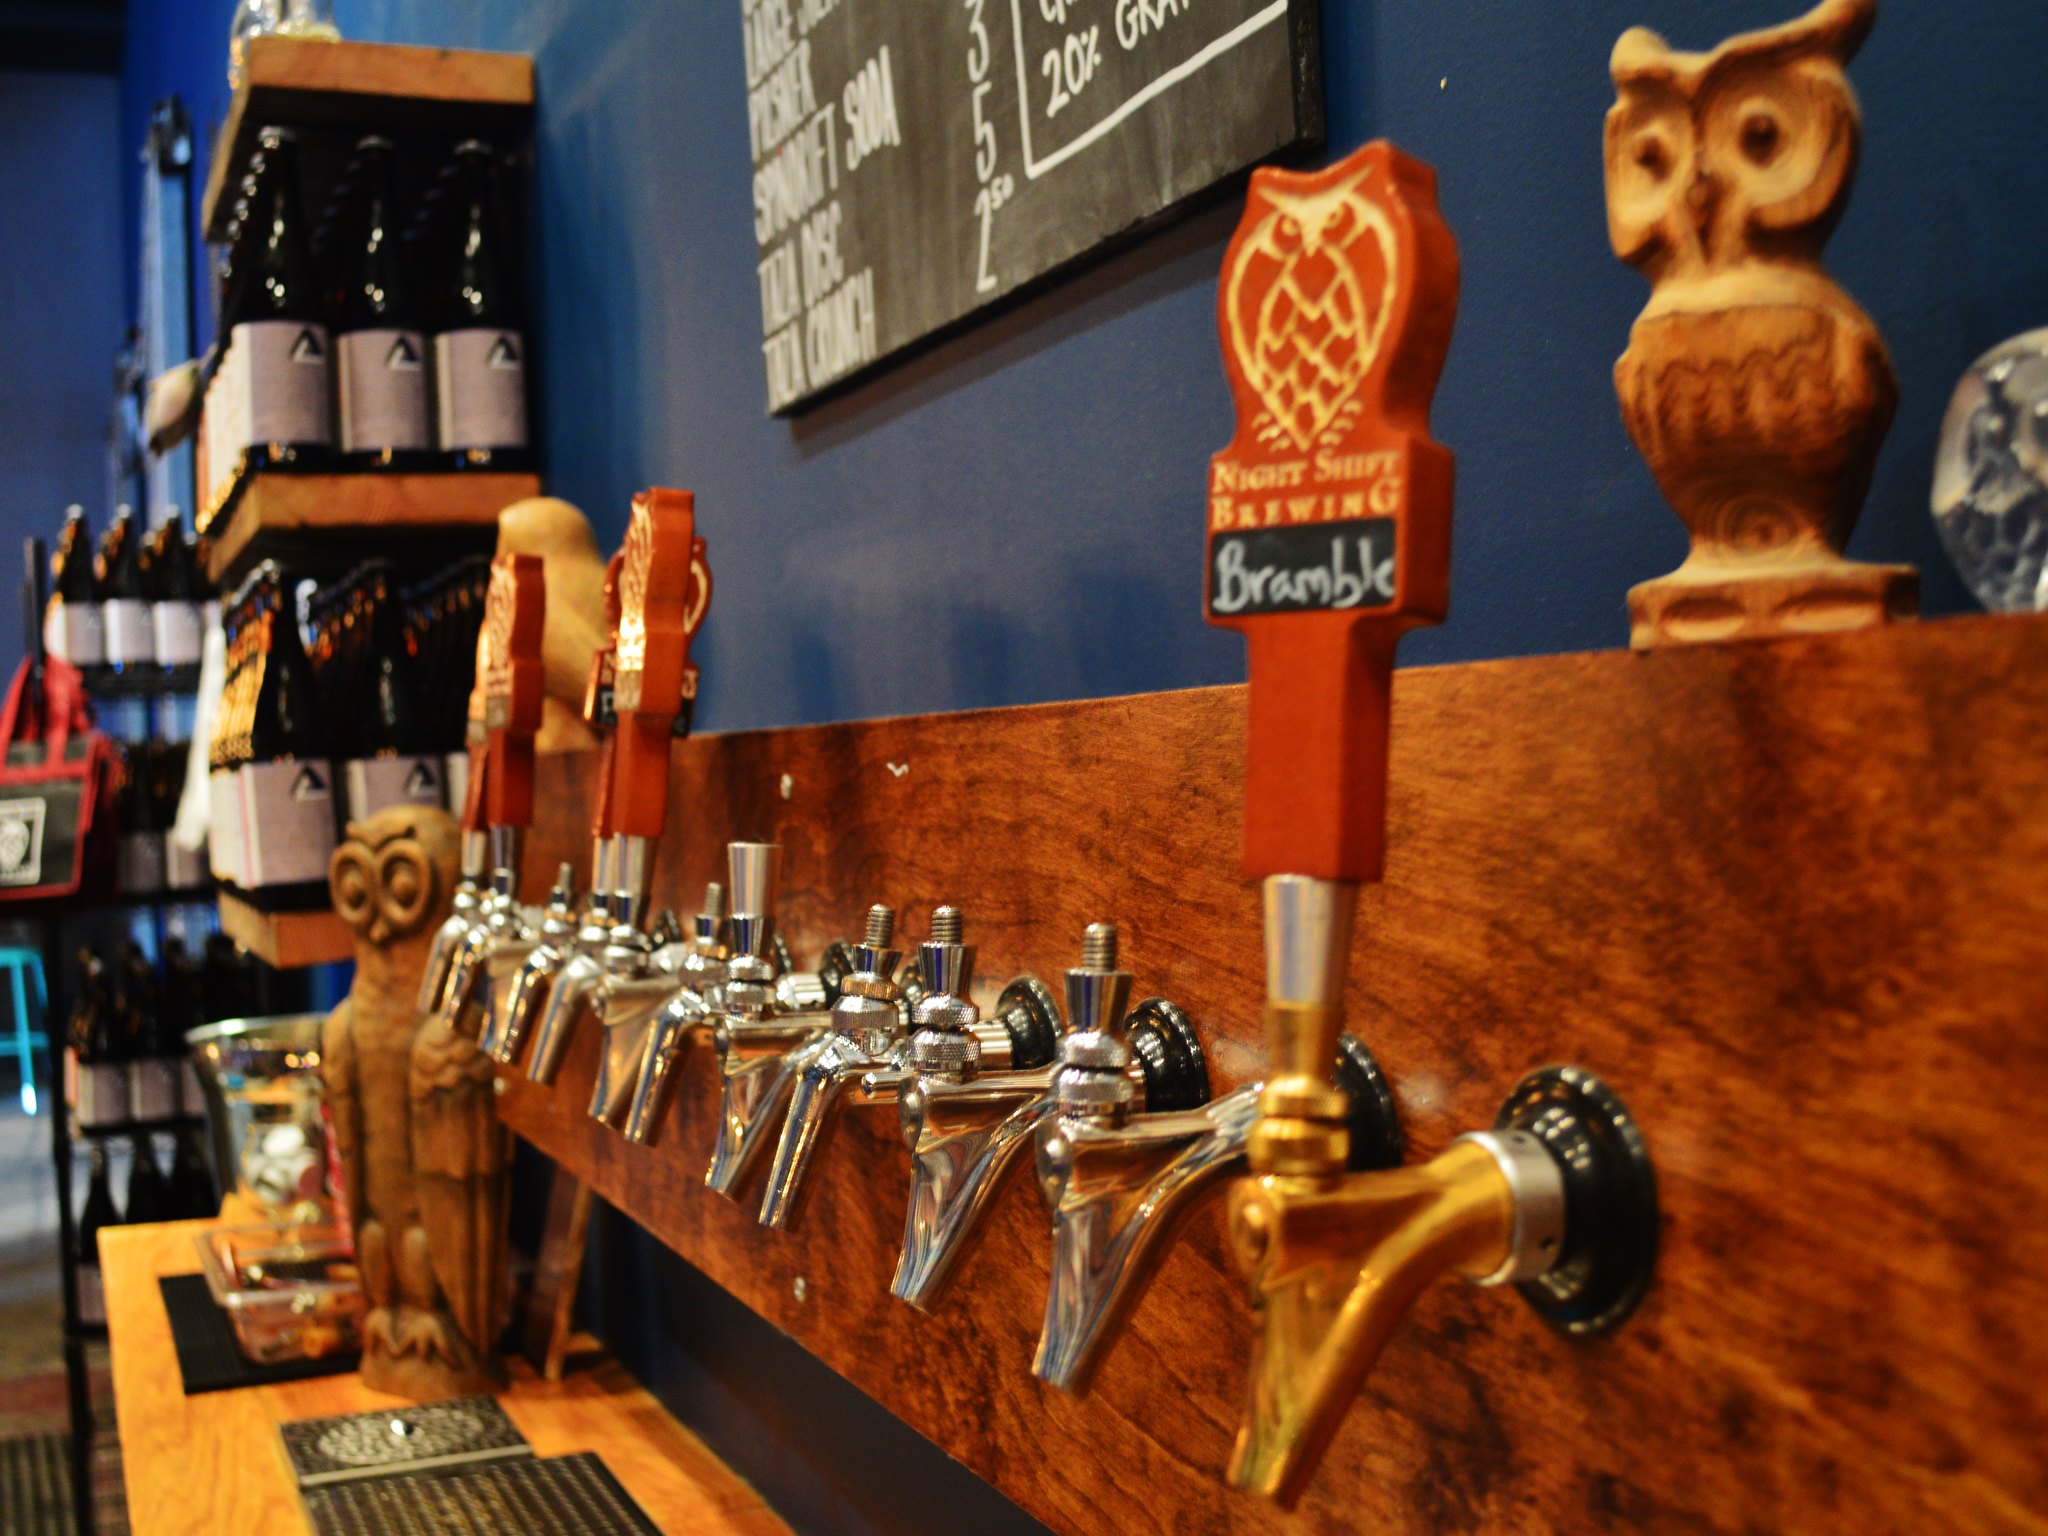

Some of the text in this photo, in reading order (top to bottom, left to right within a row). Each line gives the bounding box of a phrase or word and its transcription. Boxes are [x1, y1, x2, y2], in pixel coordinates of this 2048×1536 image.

[843, 44, 901, 171] SODA
[965, 0, 990, 83] 3
[1042, 25, 1101, 117] 20%
[972, 81, 997, 184] 5
[1212, 477, 1399, 530] BREWING
[1212, 537, 1395, 613] Bramble
